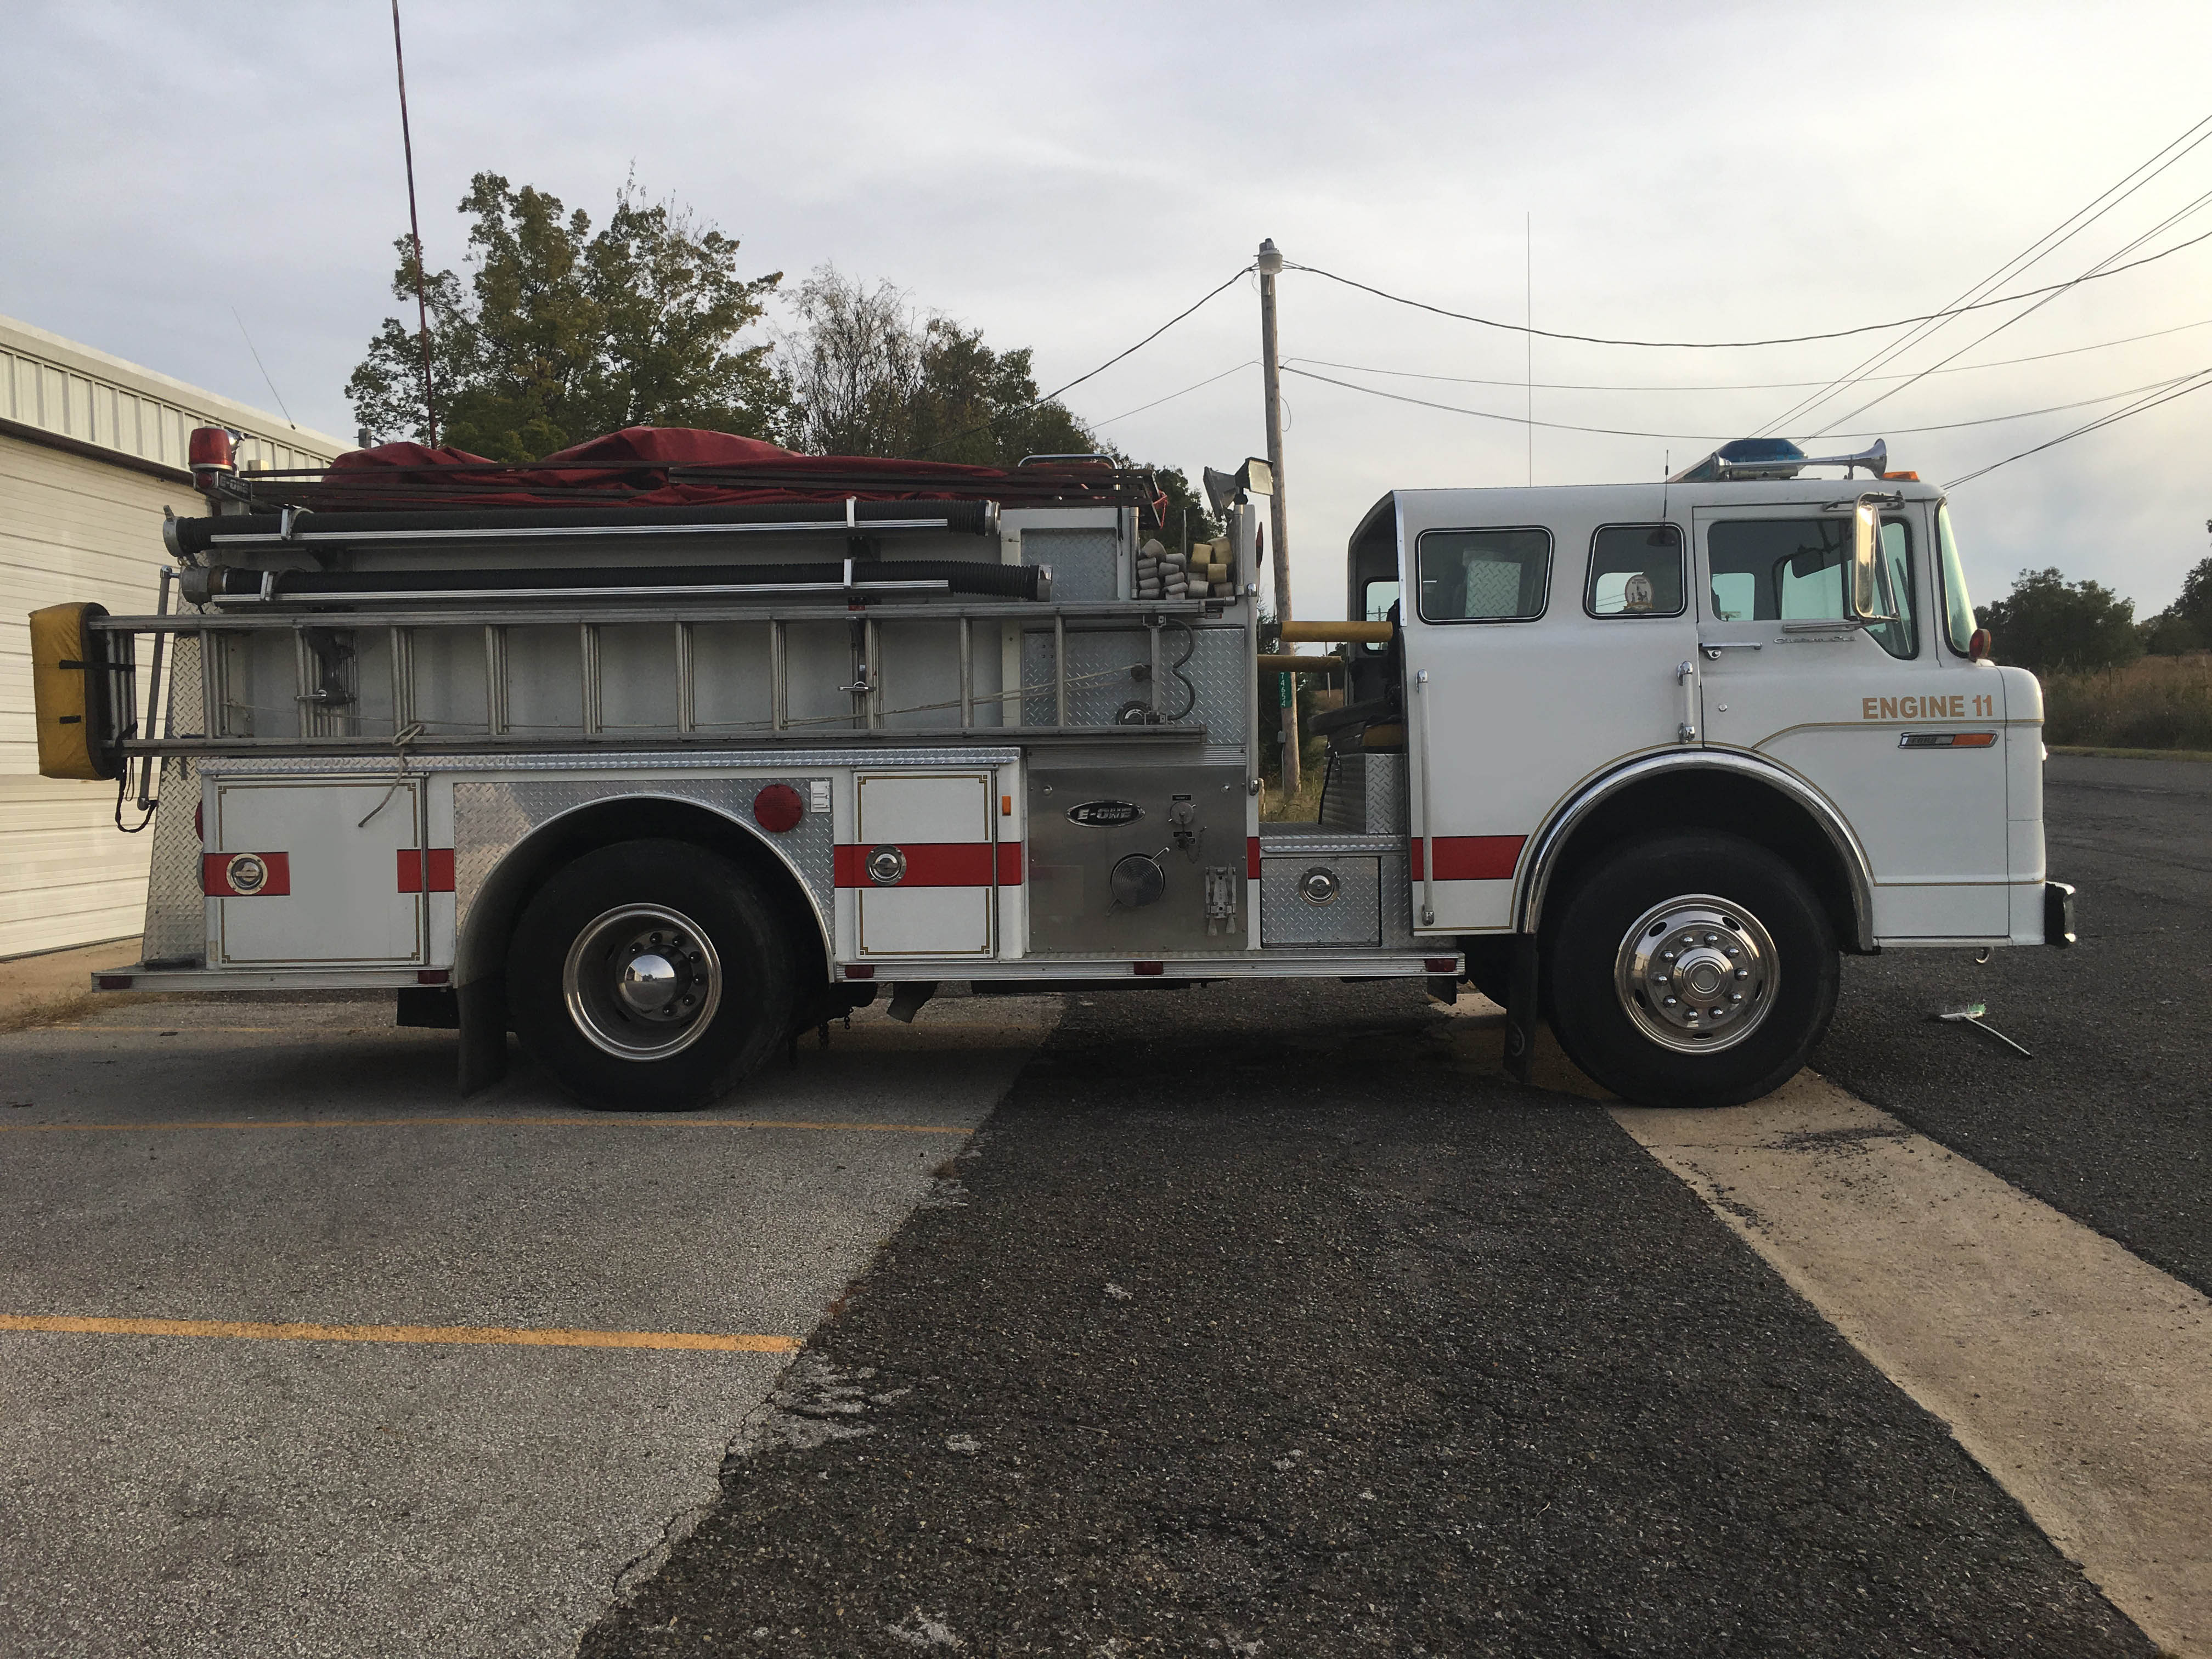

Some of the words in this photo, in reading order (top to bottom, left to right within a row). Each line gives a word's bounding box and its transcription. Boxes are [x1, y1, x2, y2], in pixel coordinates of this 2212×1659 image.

[1862, 696, 1965, 719] ENGINE
[1972, 695, 1993, 716] 11
[1077, 808, 1132, 820] E-ONE
